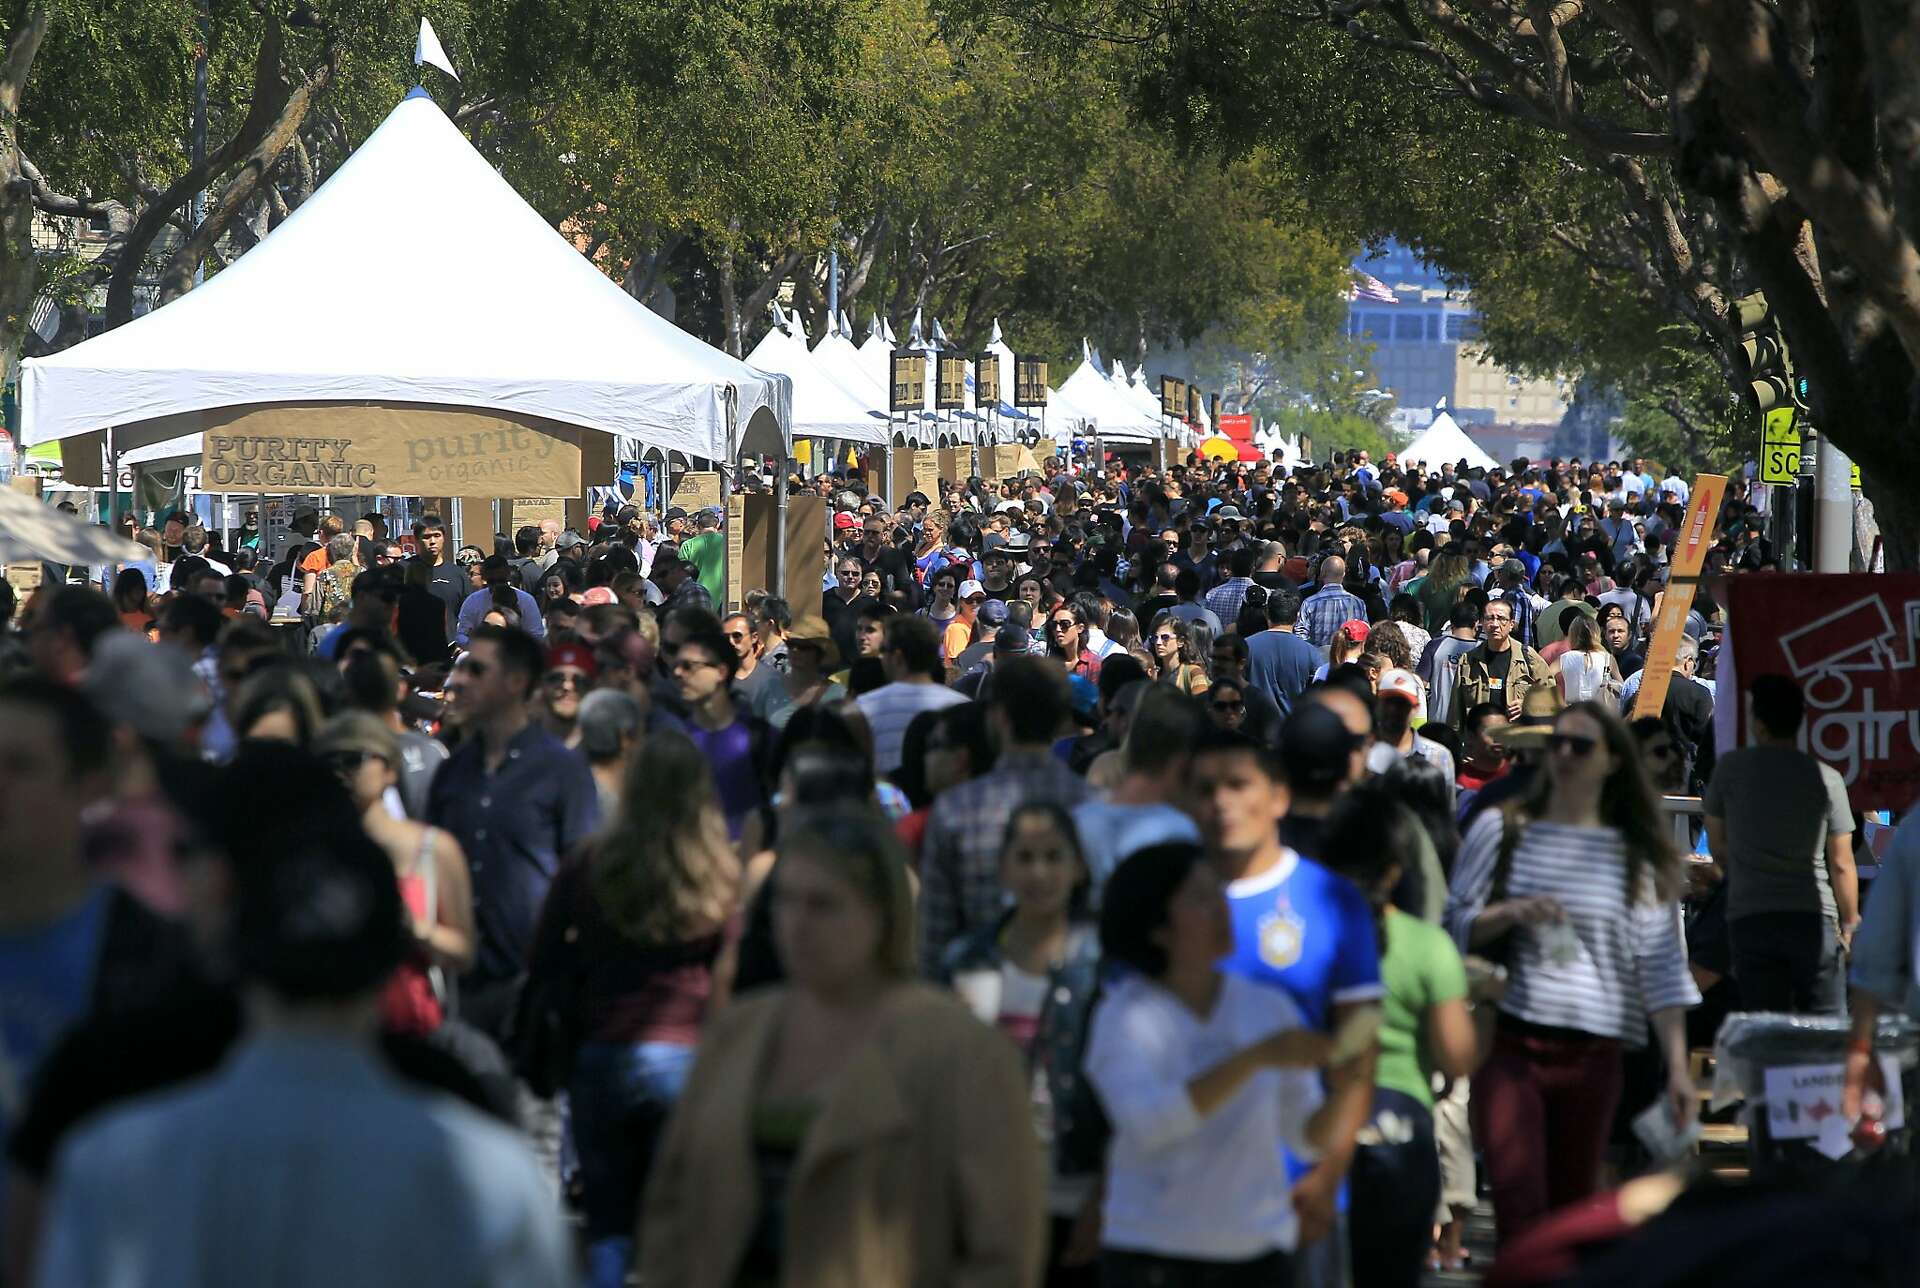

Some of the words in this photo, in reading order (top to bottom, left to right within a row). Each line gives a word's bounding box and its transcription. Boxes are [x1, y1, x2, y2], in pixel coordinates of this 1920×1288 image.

[209, 436, 352, 463] PURITY
[404, 423, 560, 473] purity
[209, 459, 376, 488] ORGANIC
[429, 455, 530, 482] organic
